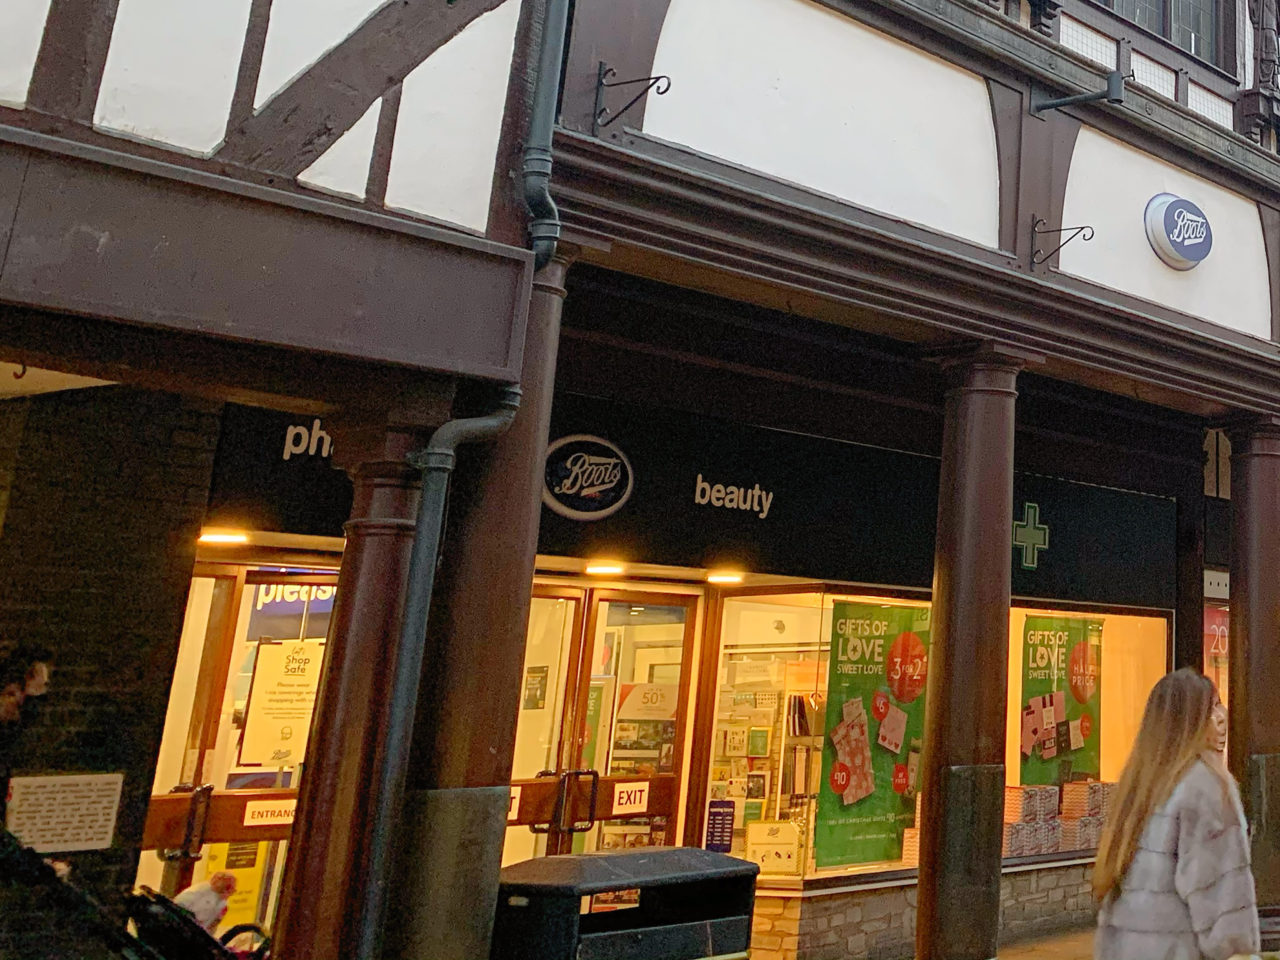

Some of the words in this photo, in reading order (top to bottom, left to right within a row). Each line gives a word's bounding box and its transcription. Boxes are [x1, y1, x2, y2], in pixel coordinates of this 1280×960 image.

[1170, 208, 1207, 246] Boots
[283, 418, 335, 461] ph
[554, 452, 624, 497] Boots
[695, 473, 774, 519] beauty
[256, 583, 337, 610] pleas
[837, 618, 870, 636] GIFTS
[872, 620, 888, 636] OF
[1027, 630, 1055, 645] GIFTS
[1056, 631, 1069, 645] OF
[837, 637, 884, 662] LOVE
[1029, 646, 1066, 668] LOVE
[284, 665, 306, 674] Safe
[285, 655, 311, 666] Shop
[836, 664, 863, 674] SWEET
[863, 664, 884, 675] LOVE
[891, 658, 902, 680] 3
[902, 665, 913, 674] FOR
[913, 659, 922, 680] 2
[1028, 670, 1049, 679] SWEET
[1050, 670, 1066, 680] LOVE
[1072, 675, 1094, 686] PRICE
[617, 789, 646, 806] EXIT
[251, 809, 296, 820] ENTRANC
